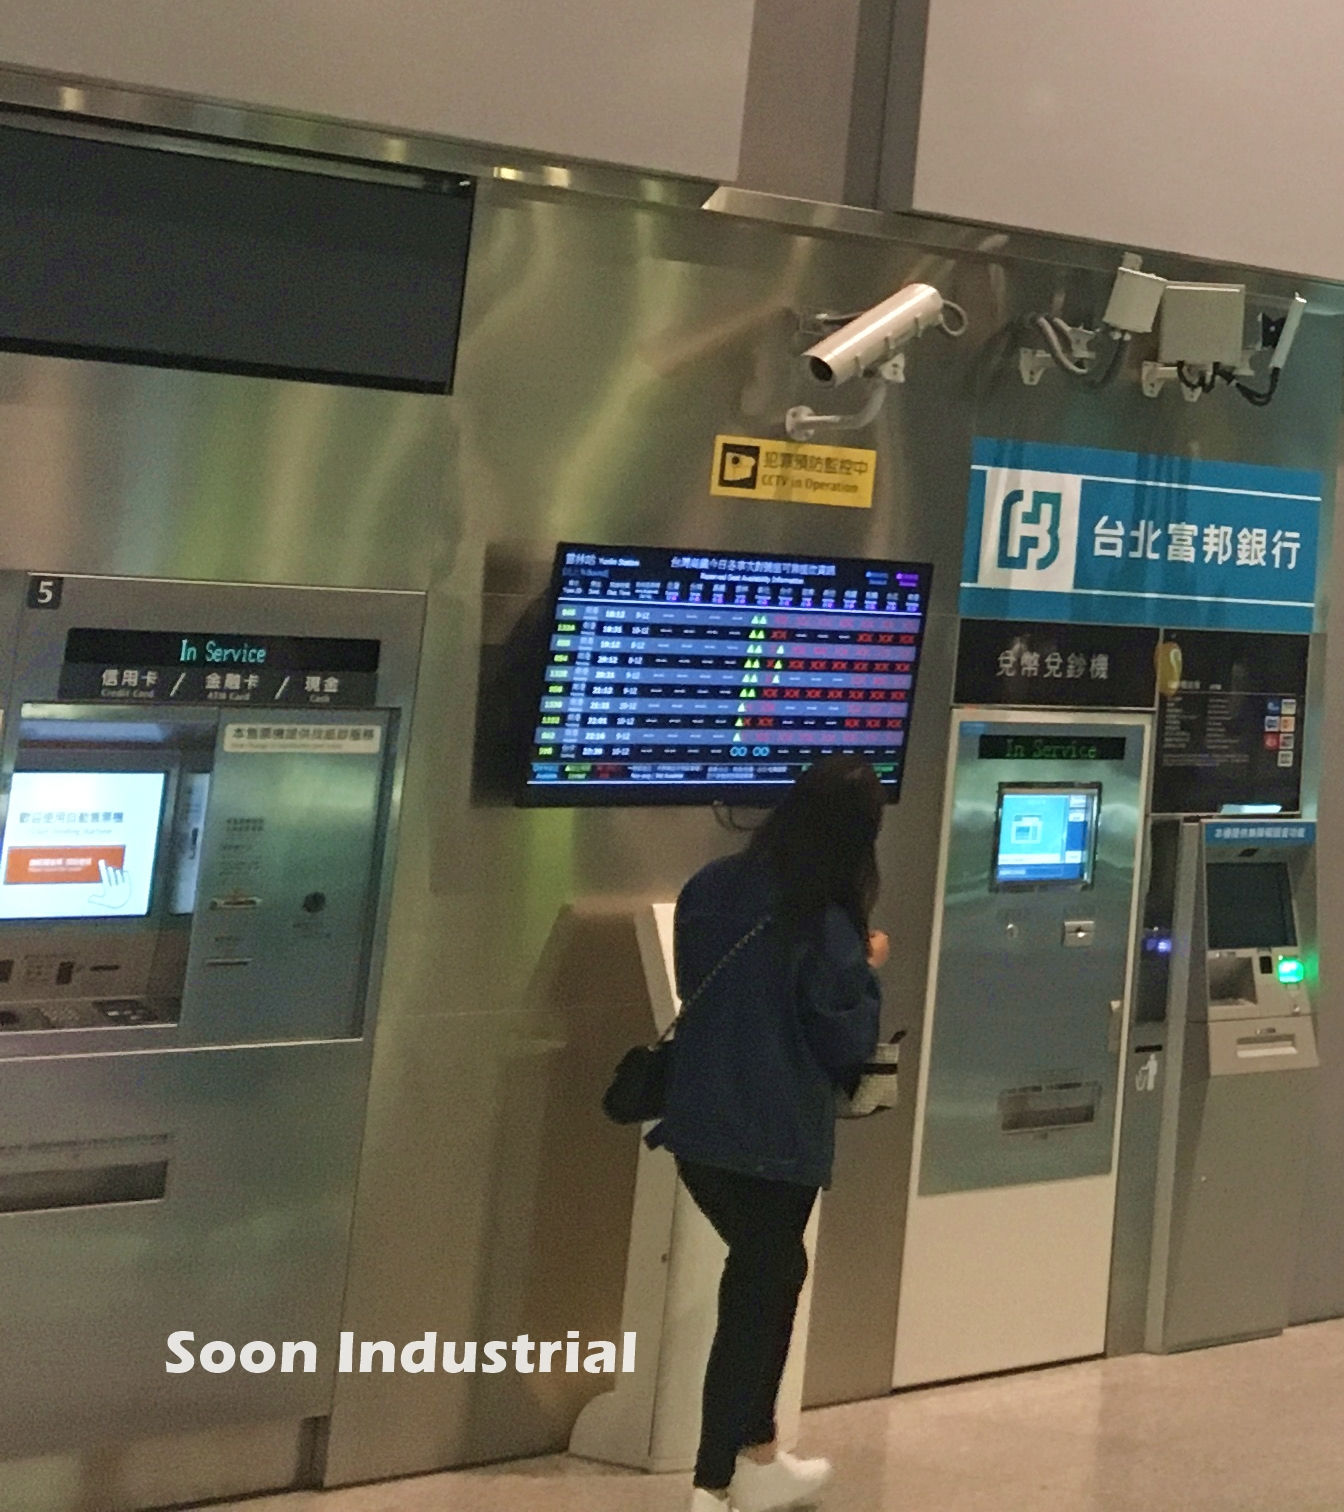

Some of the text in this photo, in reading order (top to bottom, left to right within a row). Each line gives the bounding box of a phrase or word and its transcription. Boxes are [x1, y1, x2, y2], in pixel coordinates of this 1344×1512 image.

[762, 474, 858, 493] CCTV in Operation
[1092, 515, 1302, 570] 台北富邦銀行
[37, 580, 53, 604] 5
[180, 638, 267, 664] In Service
[102, 669, 158, 688] 信用卡
[1006, 738, 1096, 758] In Service
